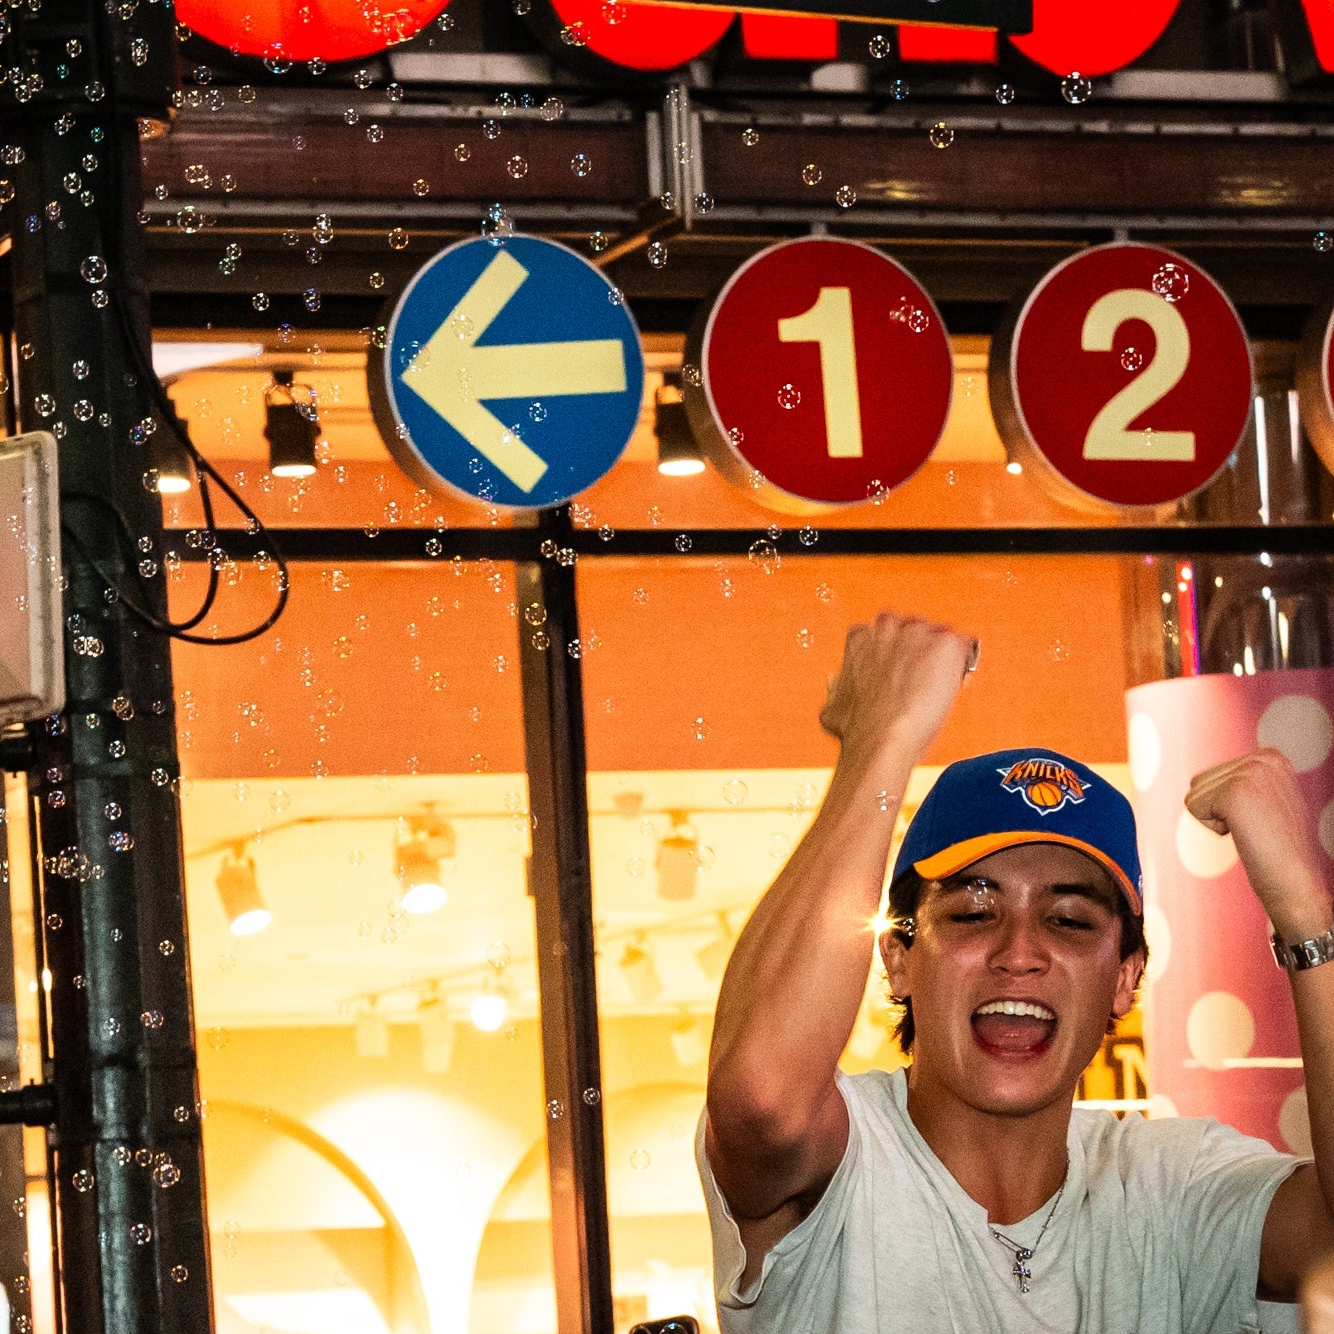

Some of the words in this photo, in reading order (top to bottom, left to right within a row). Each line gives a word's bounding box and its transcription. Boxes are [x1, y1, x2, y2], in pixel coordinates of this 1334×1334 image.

[778, 286, 863, 458] 1
[1081, 288, 1196, 461] 2
[1002, 760, 1085, 799] KNICKS
